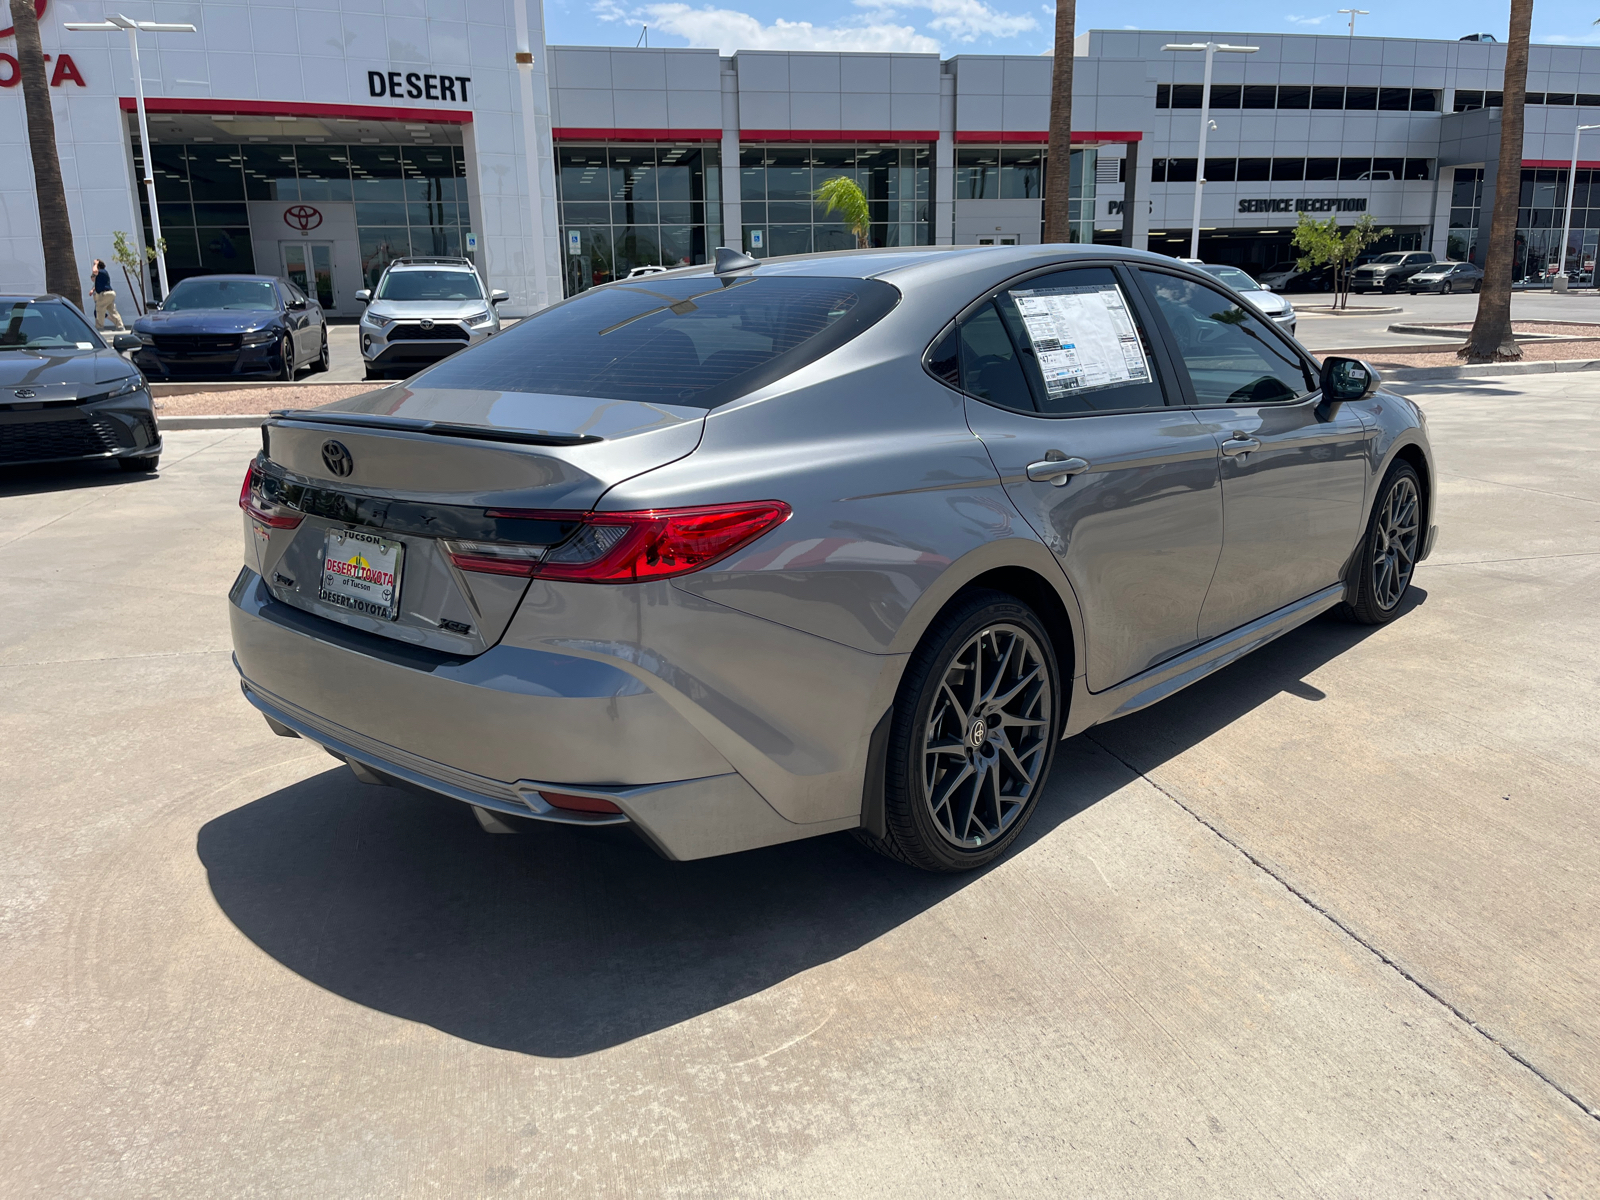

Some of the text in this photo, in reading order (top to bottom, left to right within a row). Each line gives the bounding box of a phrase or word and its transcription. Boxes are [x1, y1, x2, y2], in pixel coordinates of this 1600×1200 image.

[368, 71, 471, 102] DESERT
[1238, 198, 1367, 213] SERVICE RECEPTION
[344, 531, 380, 545] TUCSON
[326, 558, 394, 588] DESERT TOYOTA
[342, 578, 371, 592] of Tucson
[322, 591, 387, 618] DESERT TOYOTA
